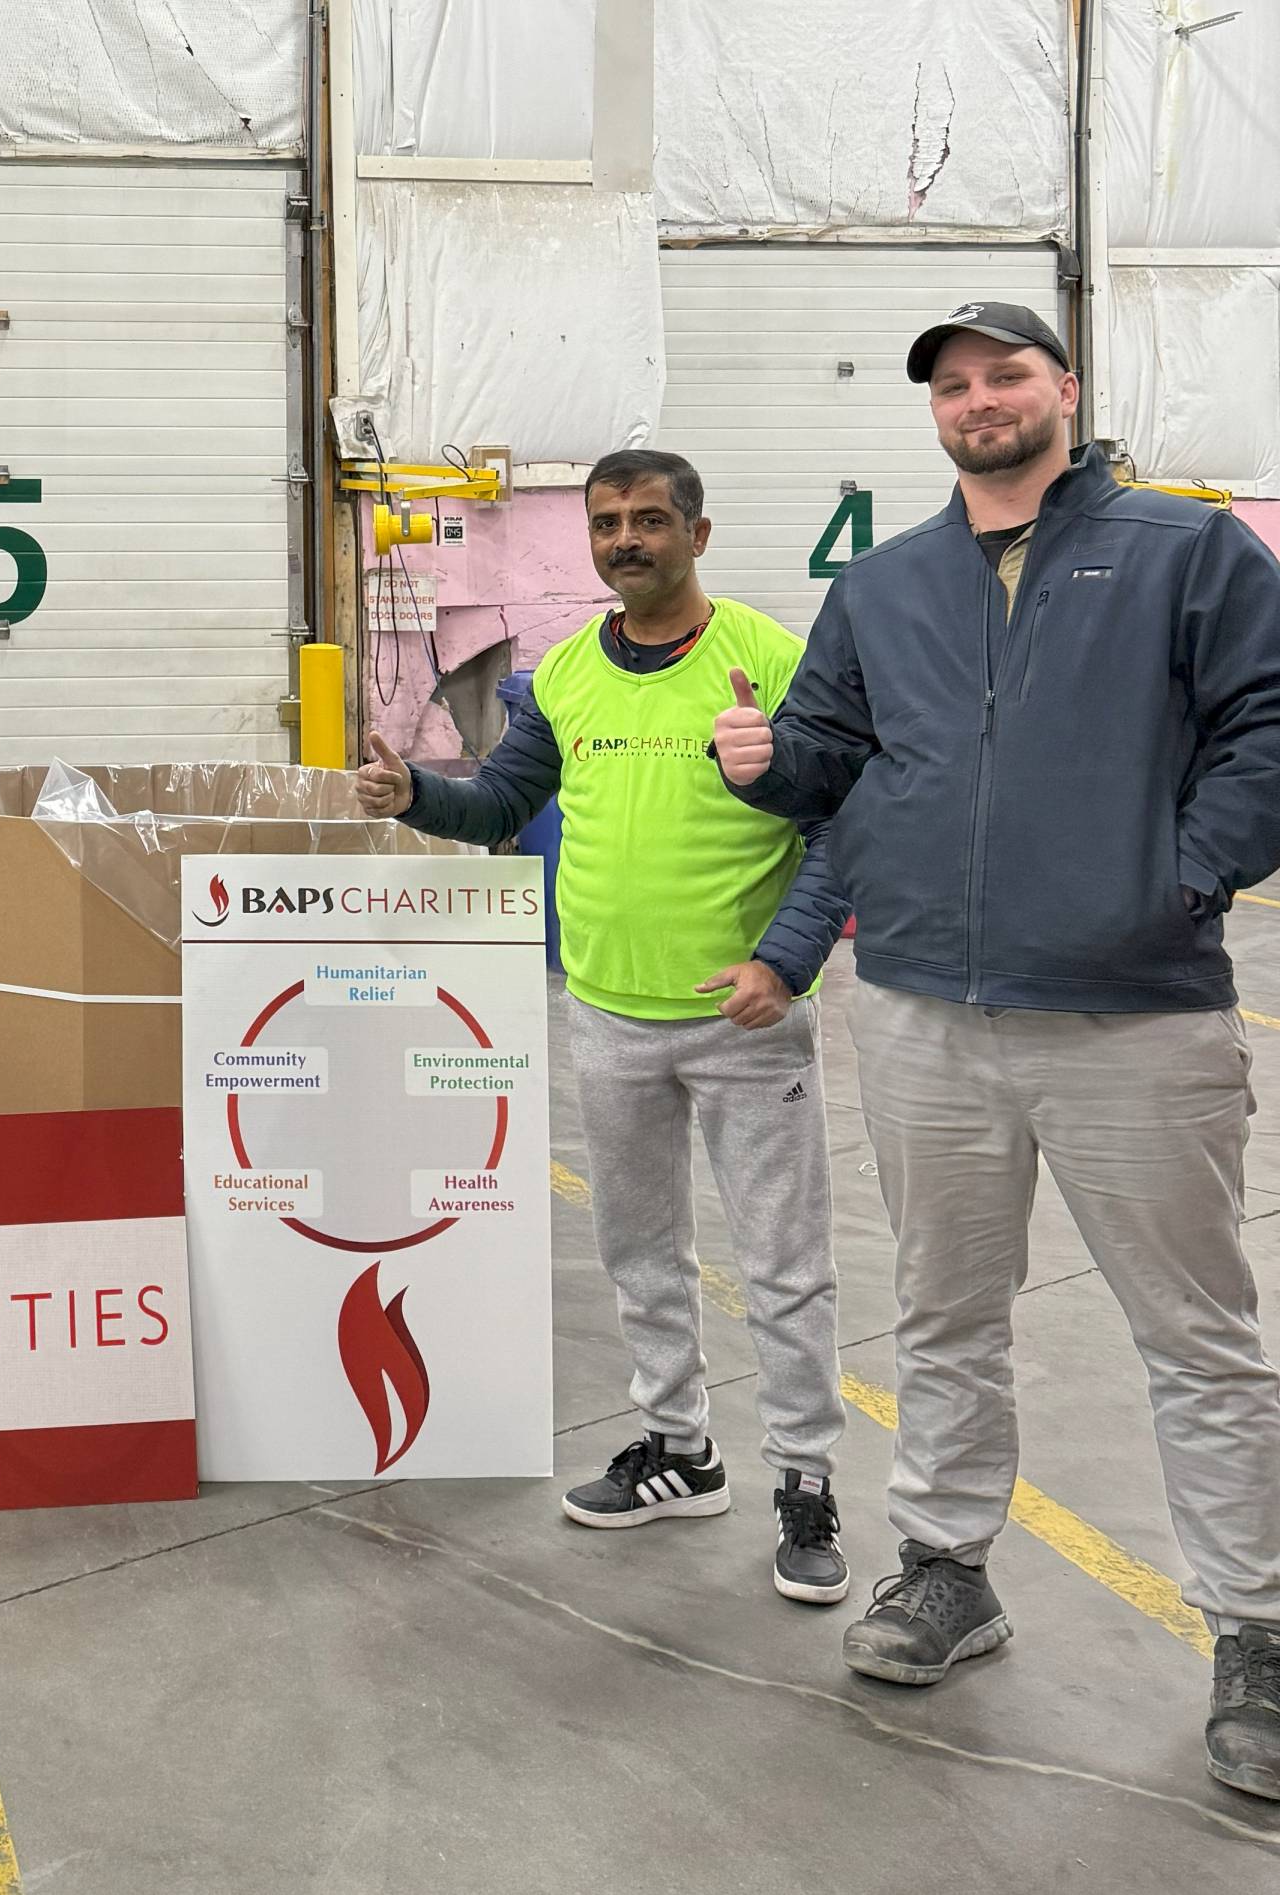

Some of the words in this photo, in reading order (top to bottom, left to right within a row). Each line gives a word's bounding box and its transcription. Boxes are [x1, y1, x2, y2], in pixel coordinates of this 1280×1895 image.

[445, 528, 461, 537] 045
[809, 490, 873, 578] 4
[384, 580, 397, 588] DO
[400, 580, 419, 588] NOT
[370, 596, 399, 604] STAND
[402, 596, 435, 604] UNDER
[592, 738, 628, 750] BAPS
[630, 737, 709, 752] CHARITIE
[242, 887, 335, 914] BAPS
[341, 887, 538, 915] CHARITIES
[317, 965, 427, 980] Humanitarian
[349, 987, 395, 1001] Relief
[214, 1052, 306, 1069] Community
[413, 1054, 529, 1069] Environmental
[206, 1073, 320, 1090] Empowerment
[430, 1076, 514, 1090] Protection
[214, 1175, 309, 1190] Educational
[445, 1175, 498, 1190] Health
[228, 1197, 295, 1211] Services
[429, 1197, 515, 1211] Awareness
